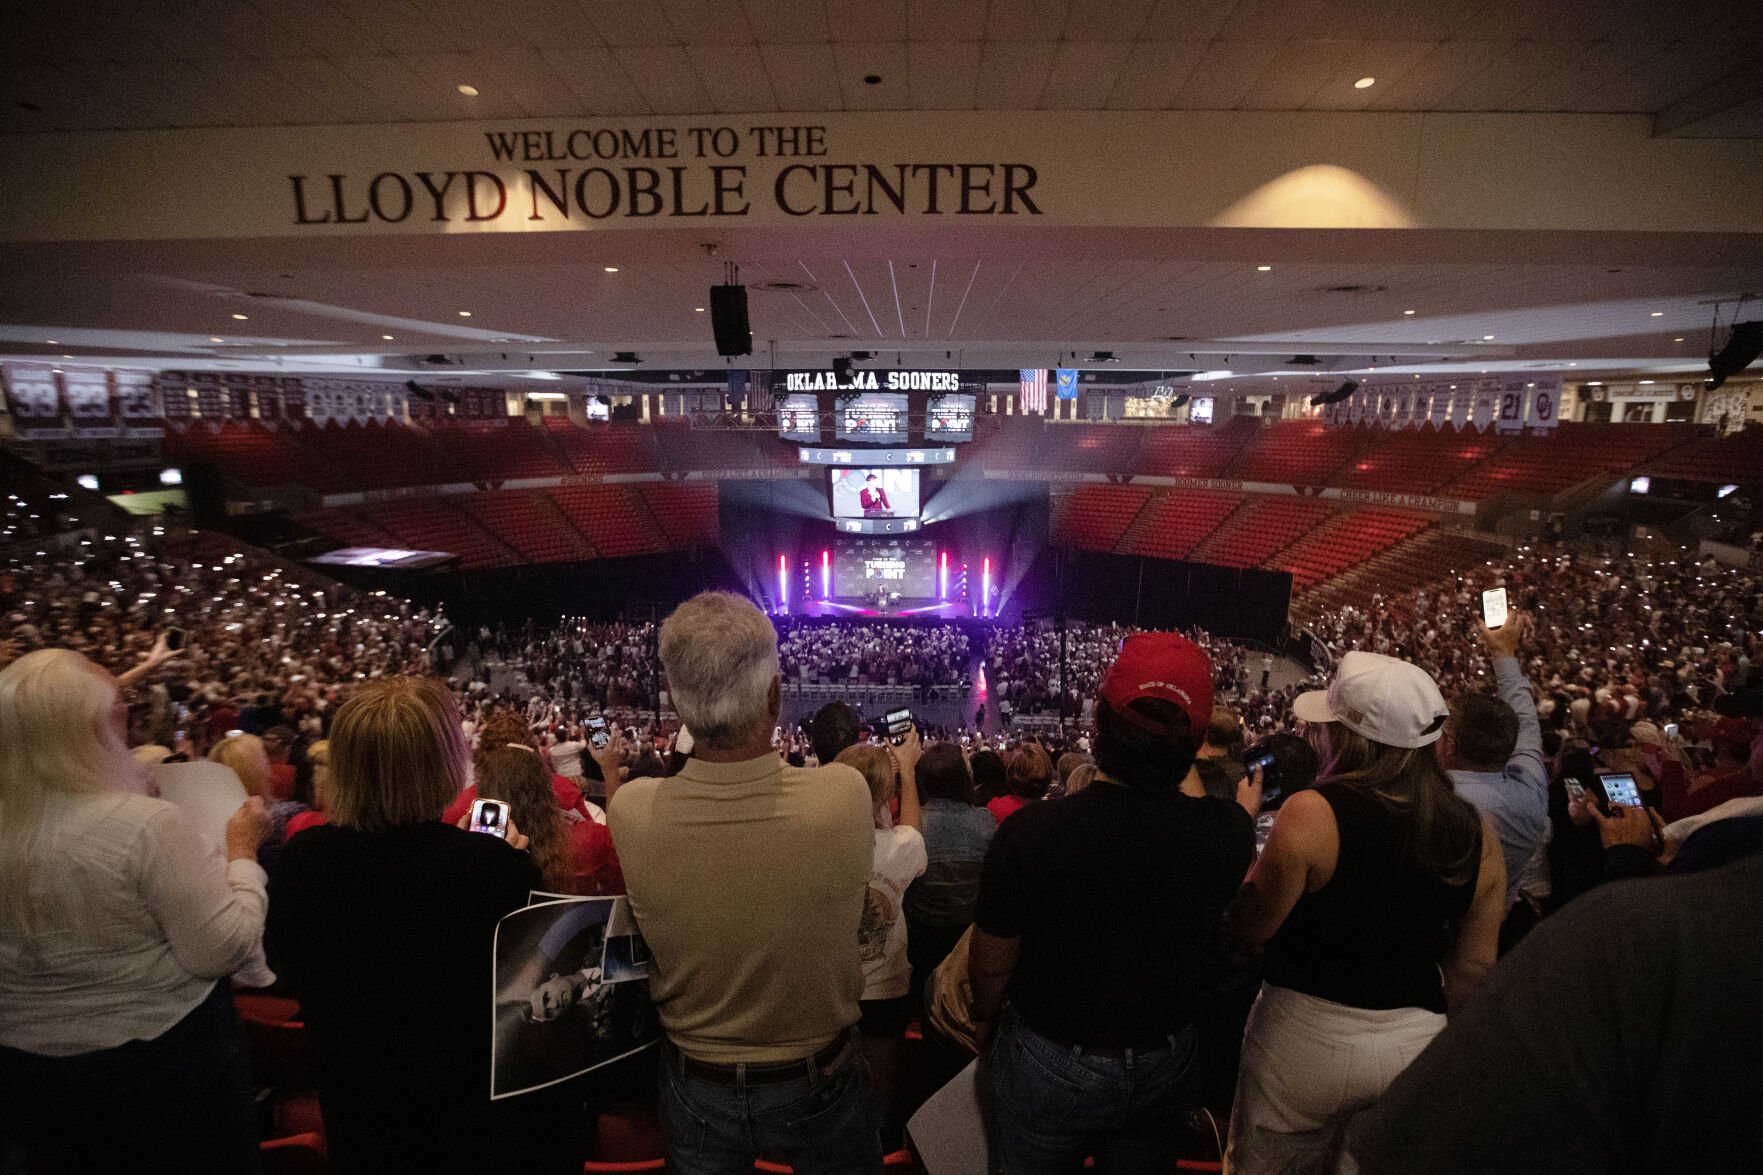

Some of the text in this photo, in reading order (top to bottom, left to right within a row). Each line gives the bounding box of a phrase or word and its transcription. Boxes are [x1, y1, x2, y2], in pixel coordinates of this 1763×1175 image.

[485, 126, 828, 161] WELCOME TO THE
[287, 163, 1044, 225] LLOYD NOBLE CENTER
[786, 371, 959, 391] OKLAHMA SOONERS
[1500, 392, 1521, 420] 21
[1175, 478, 1243, 491] BOOMER SOONER
[865, 569, 906, 580] POINT
